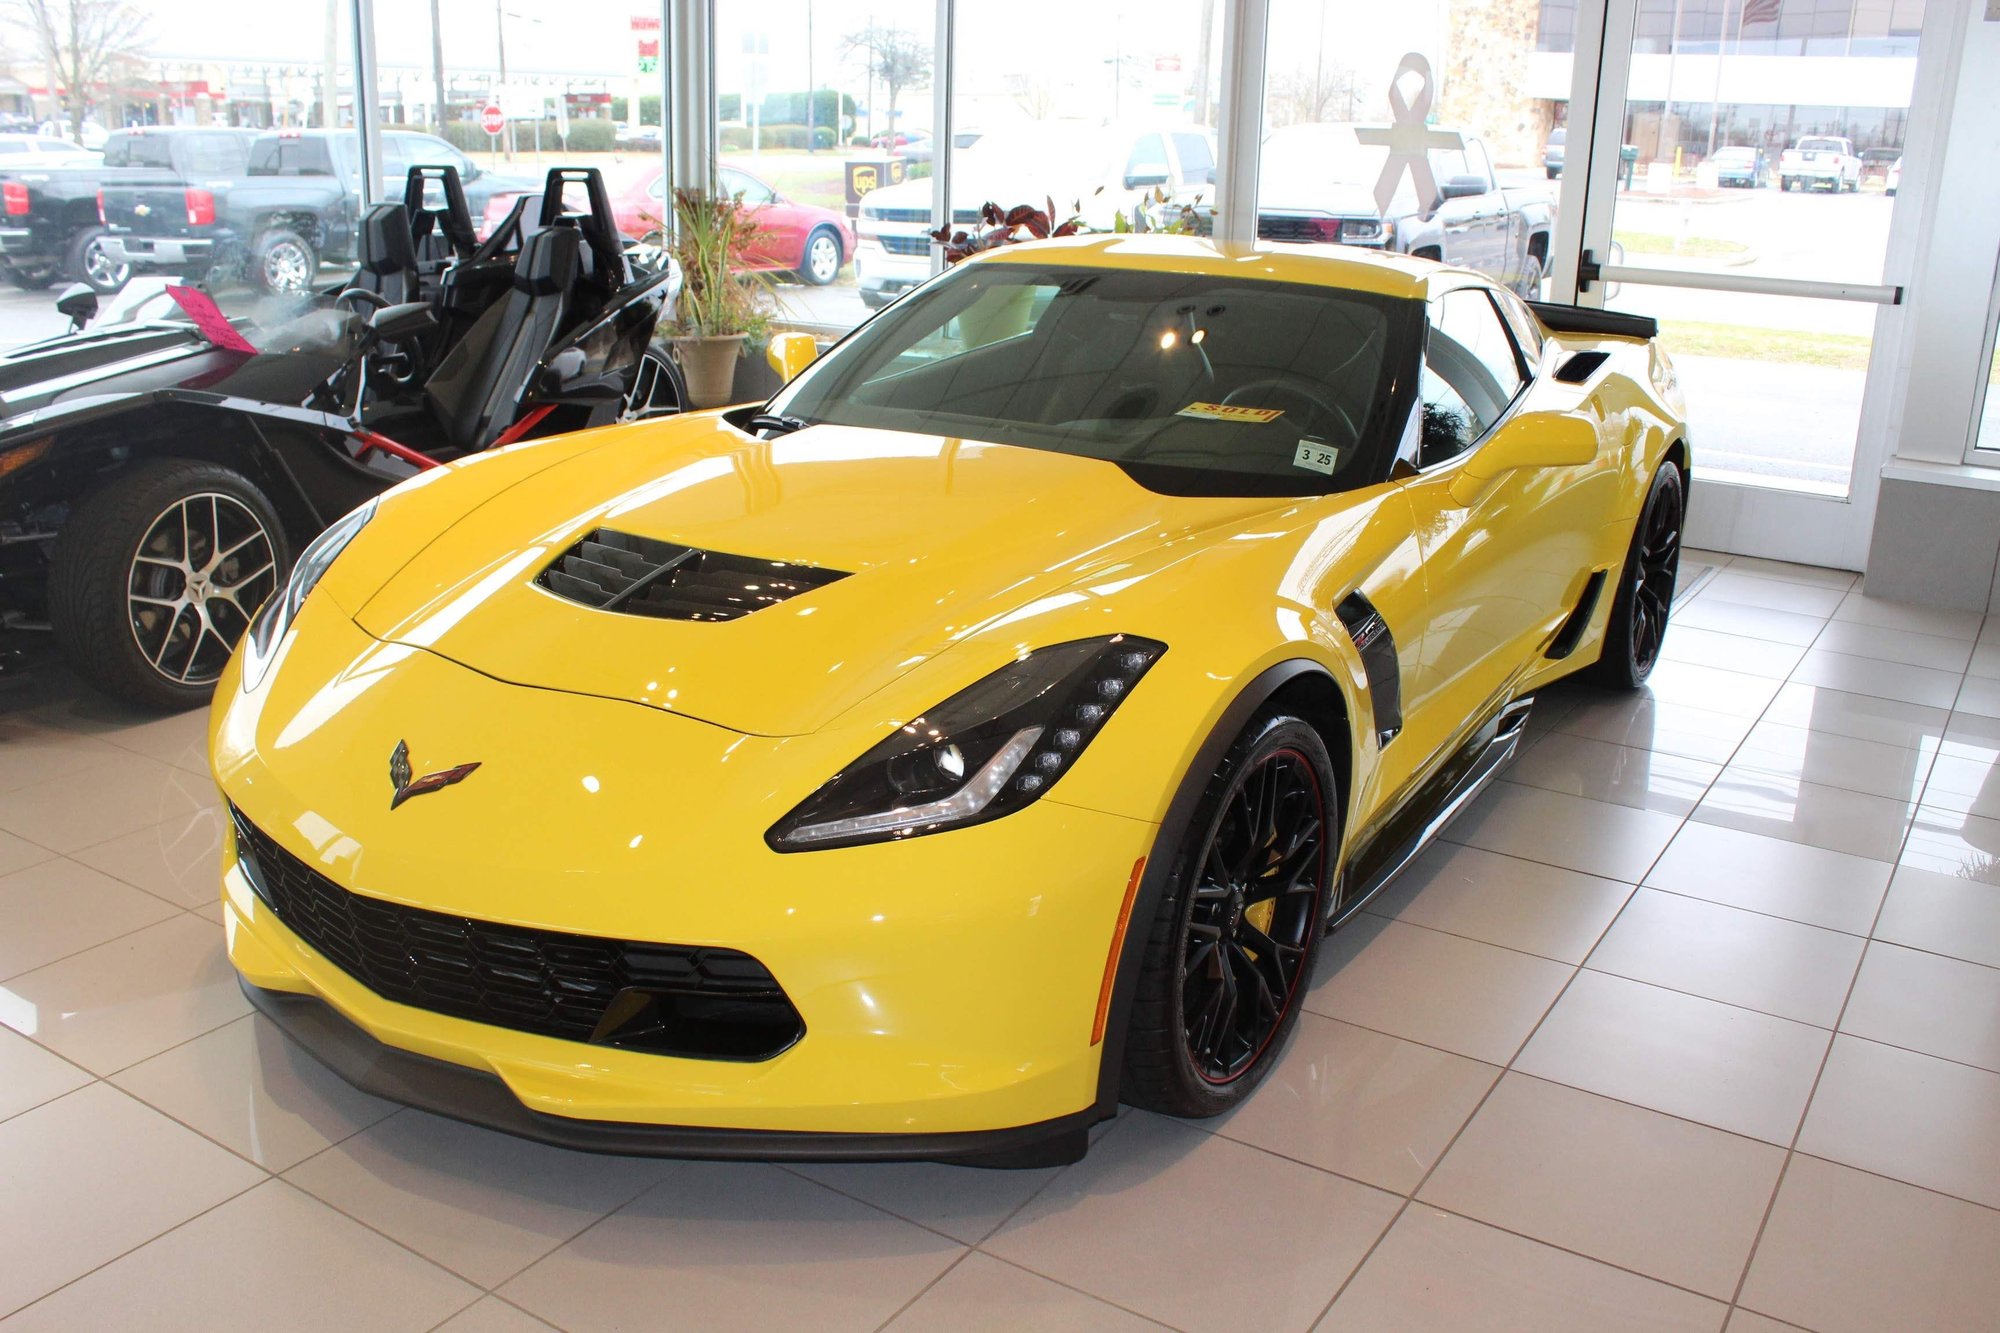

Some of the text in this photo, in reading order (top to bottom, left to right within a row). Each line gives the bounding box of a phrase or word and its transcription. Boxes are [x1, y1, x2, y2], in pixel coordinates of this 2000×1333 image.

[482, 113, 503, 126] STOP
[1302, 449, 1332, 466] 3 25
